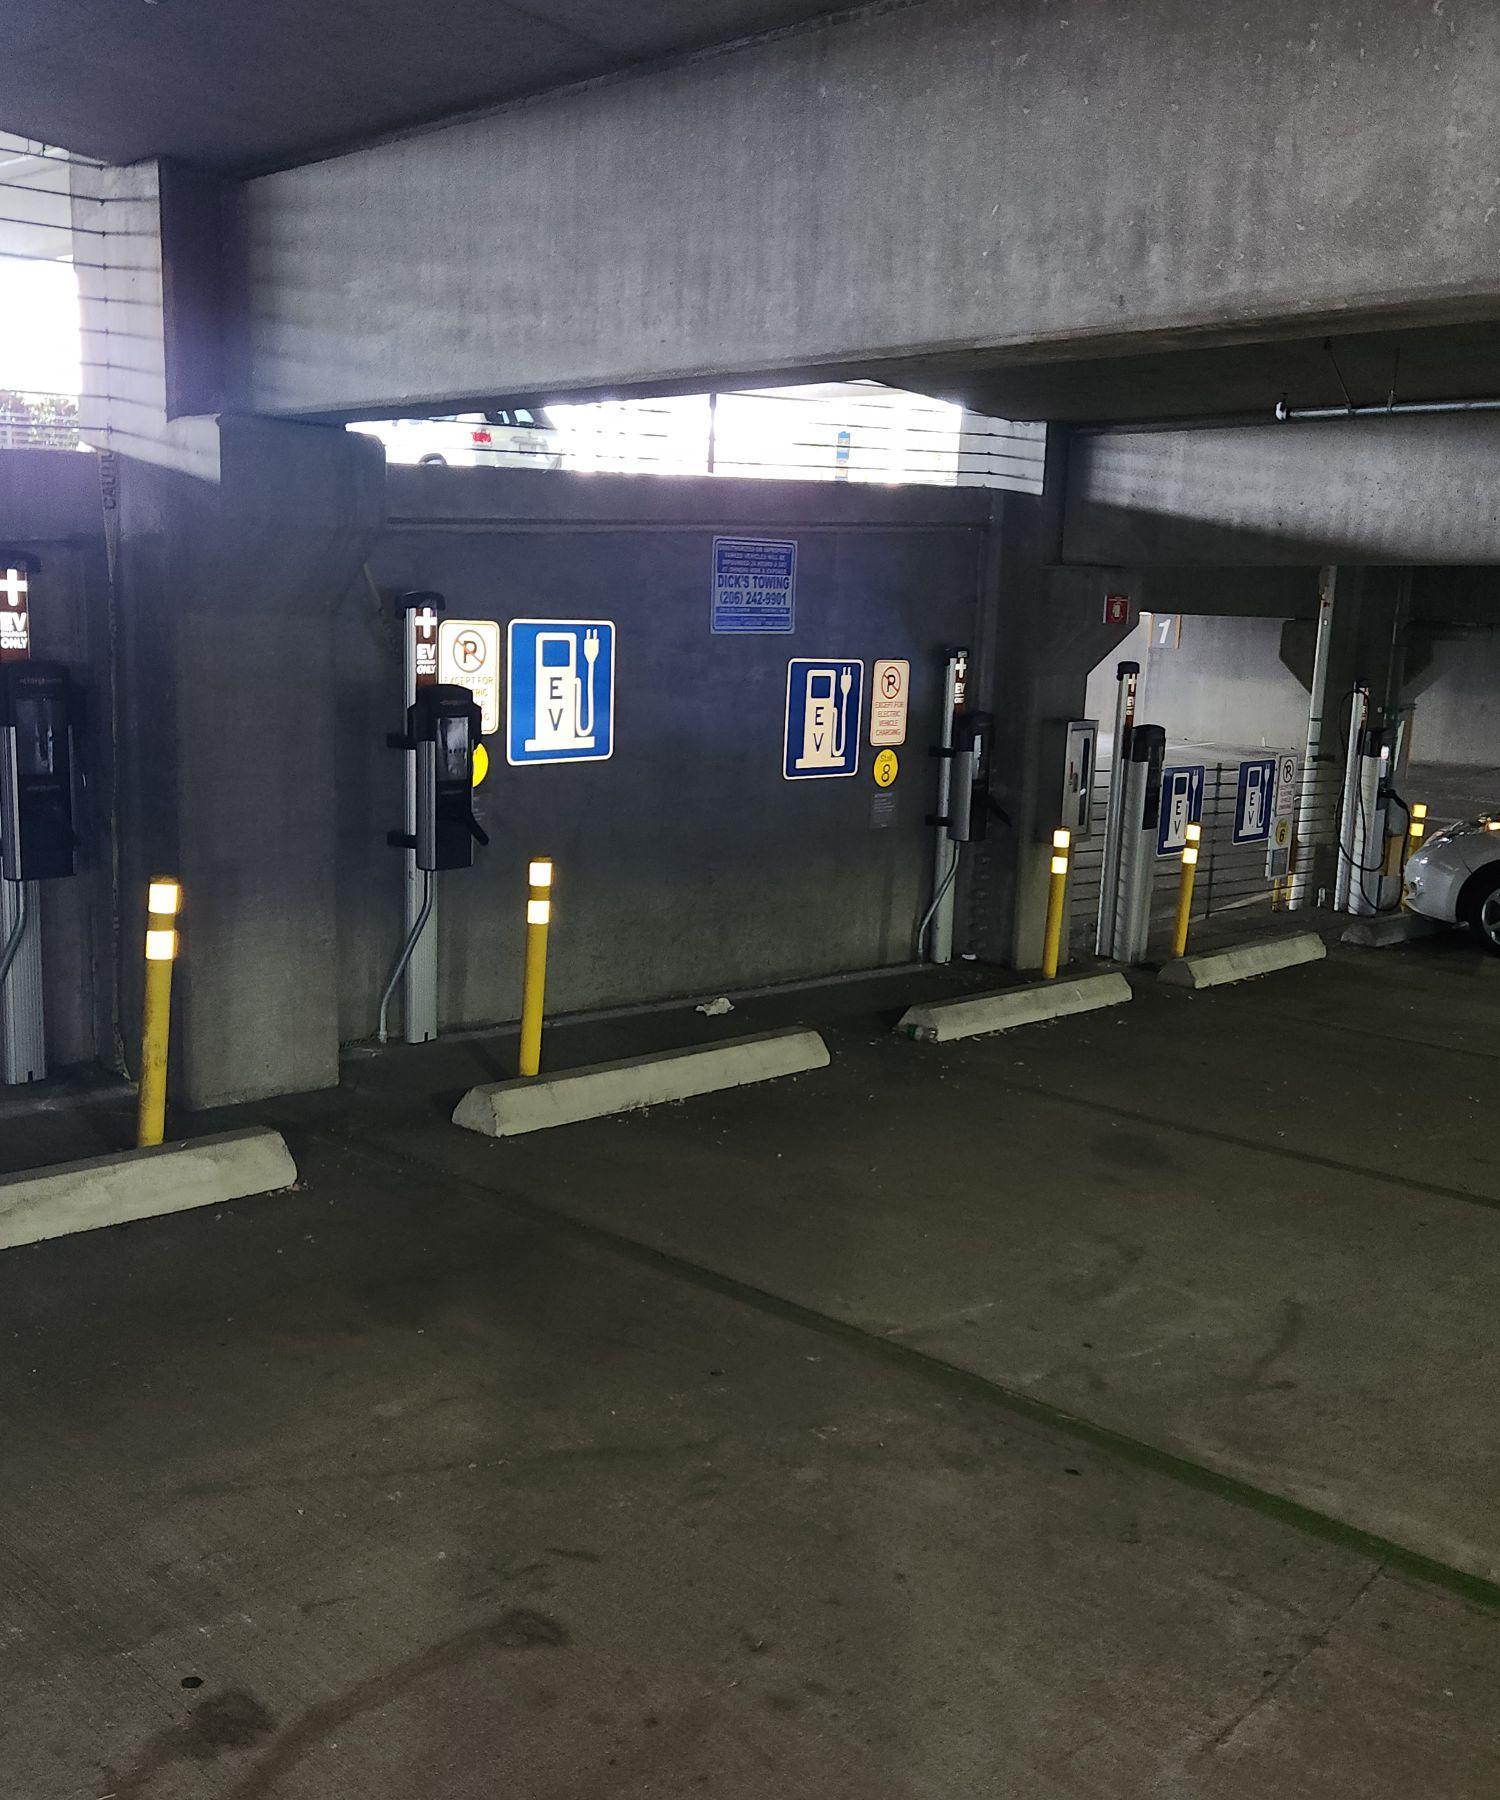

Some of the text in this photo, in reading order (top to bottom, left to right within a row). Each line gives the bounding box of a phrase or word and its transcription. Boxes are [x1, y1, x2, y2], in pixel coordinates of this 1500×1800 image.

[718, 574, 790, 590] DICK'S TOWING
[720, 591, 744, 605] (206)
[1158, 619, 1171, 645] 1
[1, 637, 28, 649] ONLY
[416, 643, 437, 660] EV
[416, 665, 437, 675] ONLY
[478, 676, 494, 685] FOR
[881, 764, 891, 783] 8
[1279, 828, 1286, 843] 6
